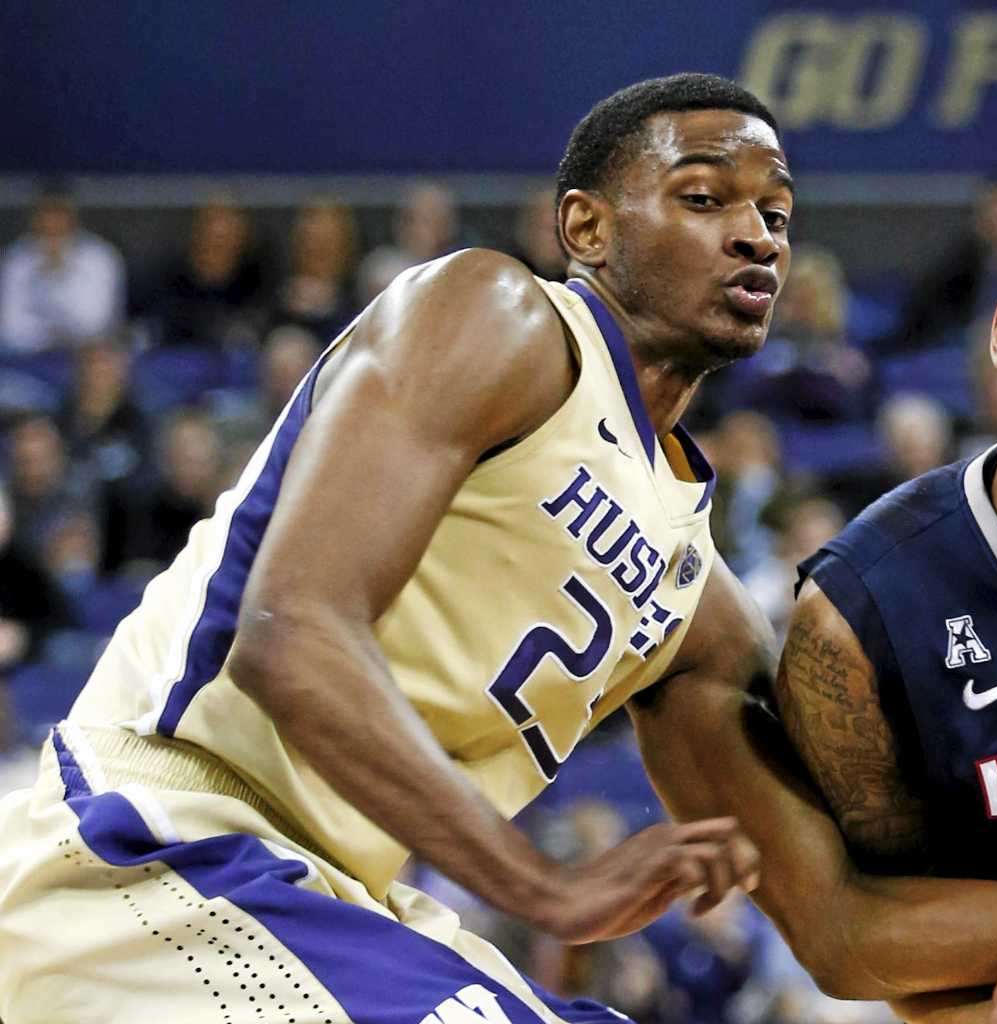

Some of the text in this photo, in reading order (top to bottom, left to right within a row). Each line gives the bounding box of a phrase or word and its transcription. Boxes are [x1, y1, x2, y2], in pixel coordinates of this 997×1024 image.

[742, 14, 930, 131] GO
[484, 570, 616, 783] 2
[945, 614, 993, 668] A
